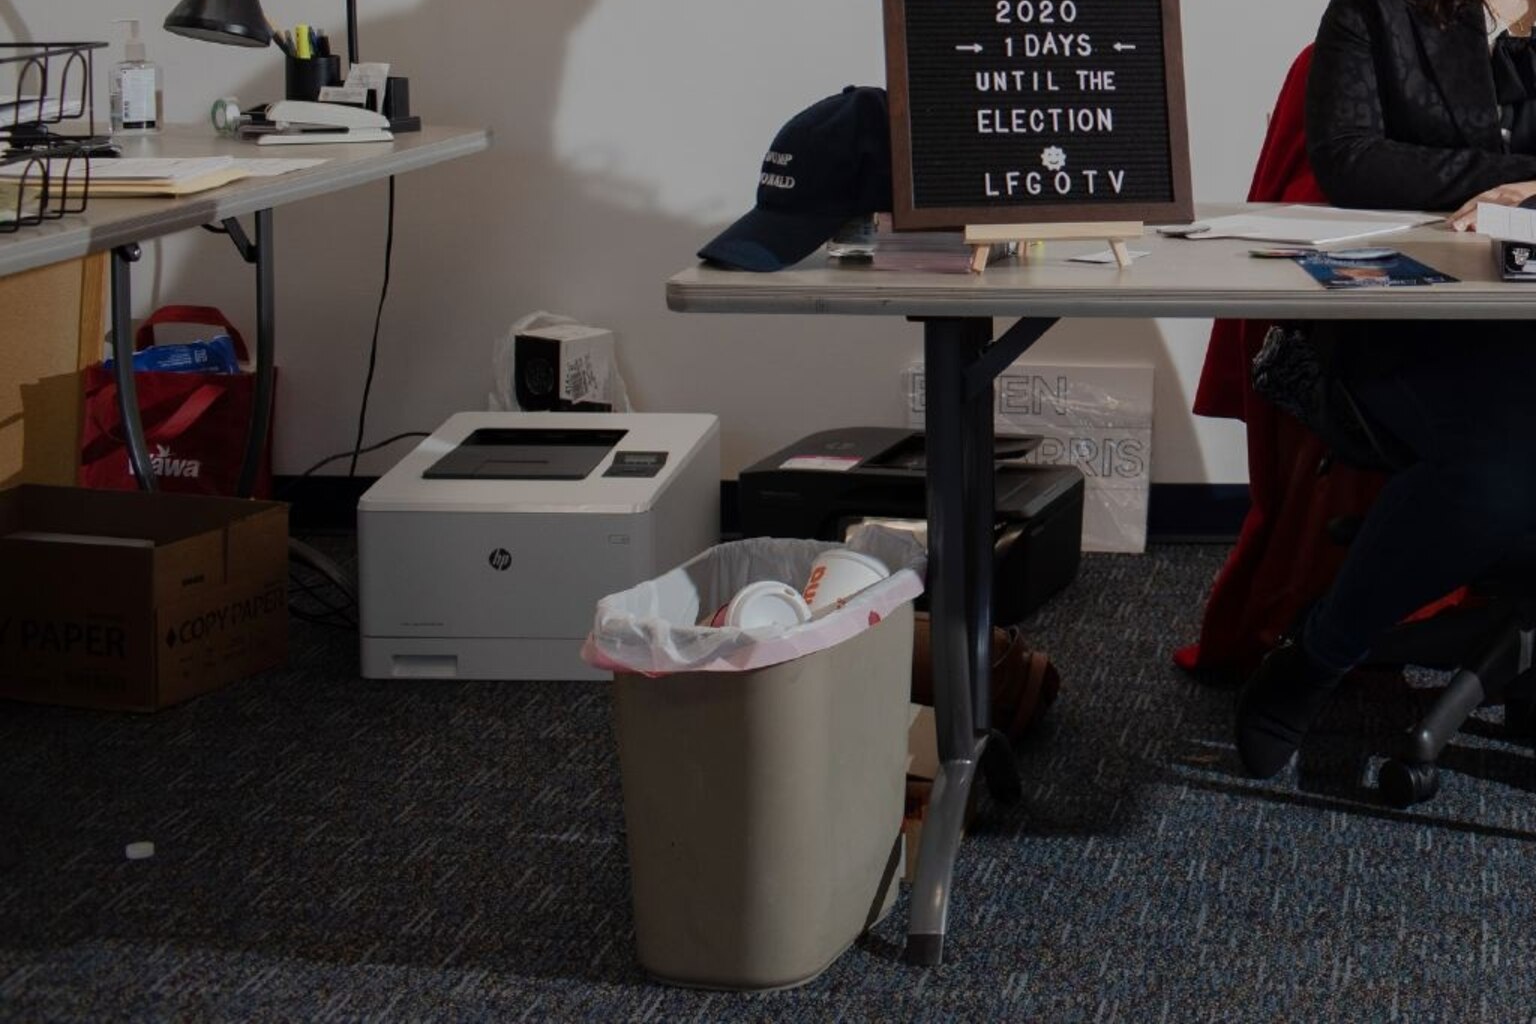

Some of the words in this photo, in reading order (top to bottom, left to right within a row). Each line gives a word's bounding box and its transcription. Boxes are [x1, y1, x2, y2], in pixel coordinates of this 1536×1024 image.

[996, 0, 1077, 23] 2020
[1005, 37, 1013, 57] 1
[1025, 32, 1092, 57] DAYS
[976, 71, 1059, 91] UNTIL
[1076, 70, 1116, 90] THE
[977, 108, 1113, 133] ELECTION
[128, 453, 201, 478] awa
[179, 607, 230, 644] COPY
[231, 587, 286, 626] PAPER
[21, 619, 125, 657] PAPER
